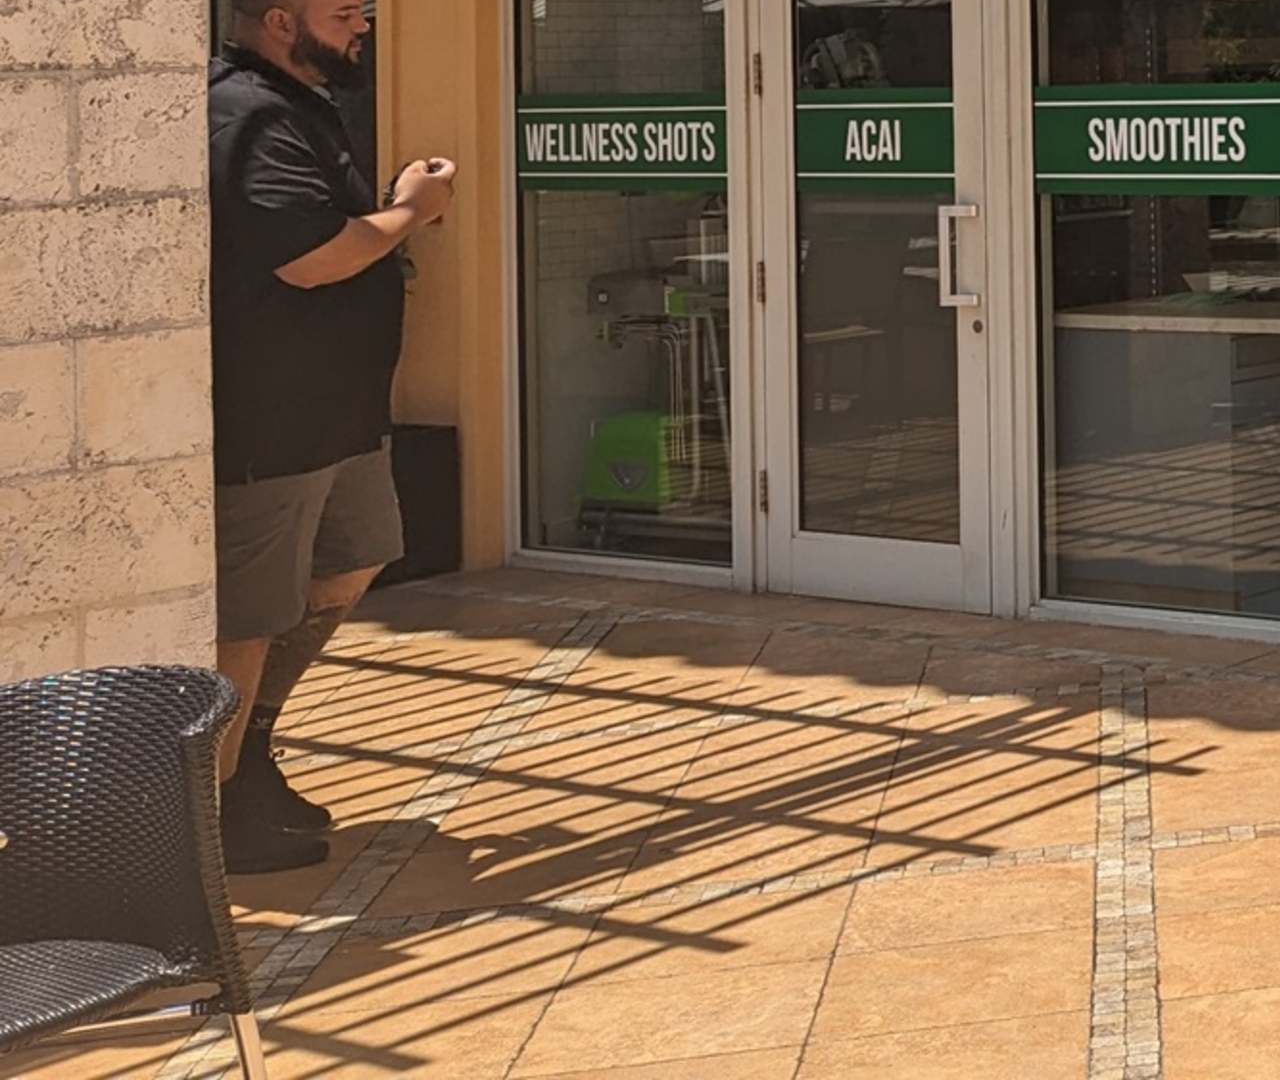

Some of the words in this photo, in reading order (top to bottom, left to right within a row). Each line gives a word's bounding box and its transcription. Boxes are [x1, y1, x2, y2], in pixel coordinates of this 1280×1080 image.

[525, 122, 638, 162] WELLNESS
[643, 121, 716, 162] SHOTS
[844, 119, 902, 161] ACAI
[1087, 116, 1246, 162] SMOOTHIES
